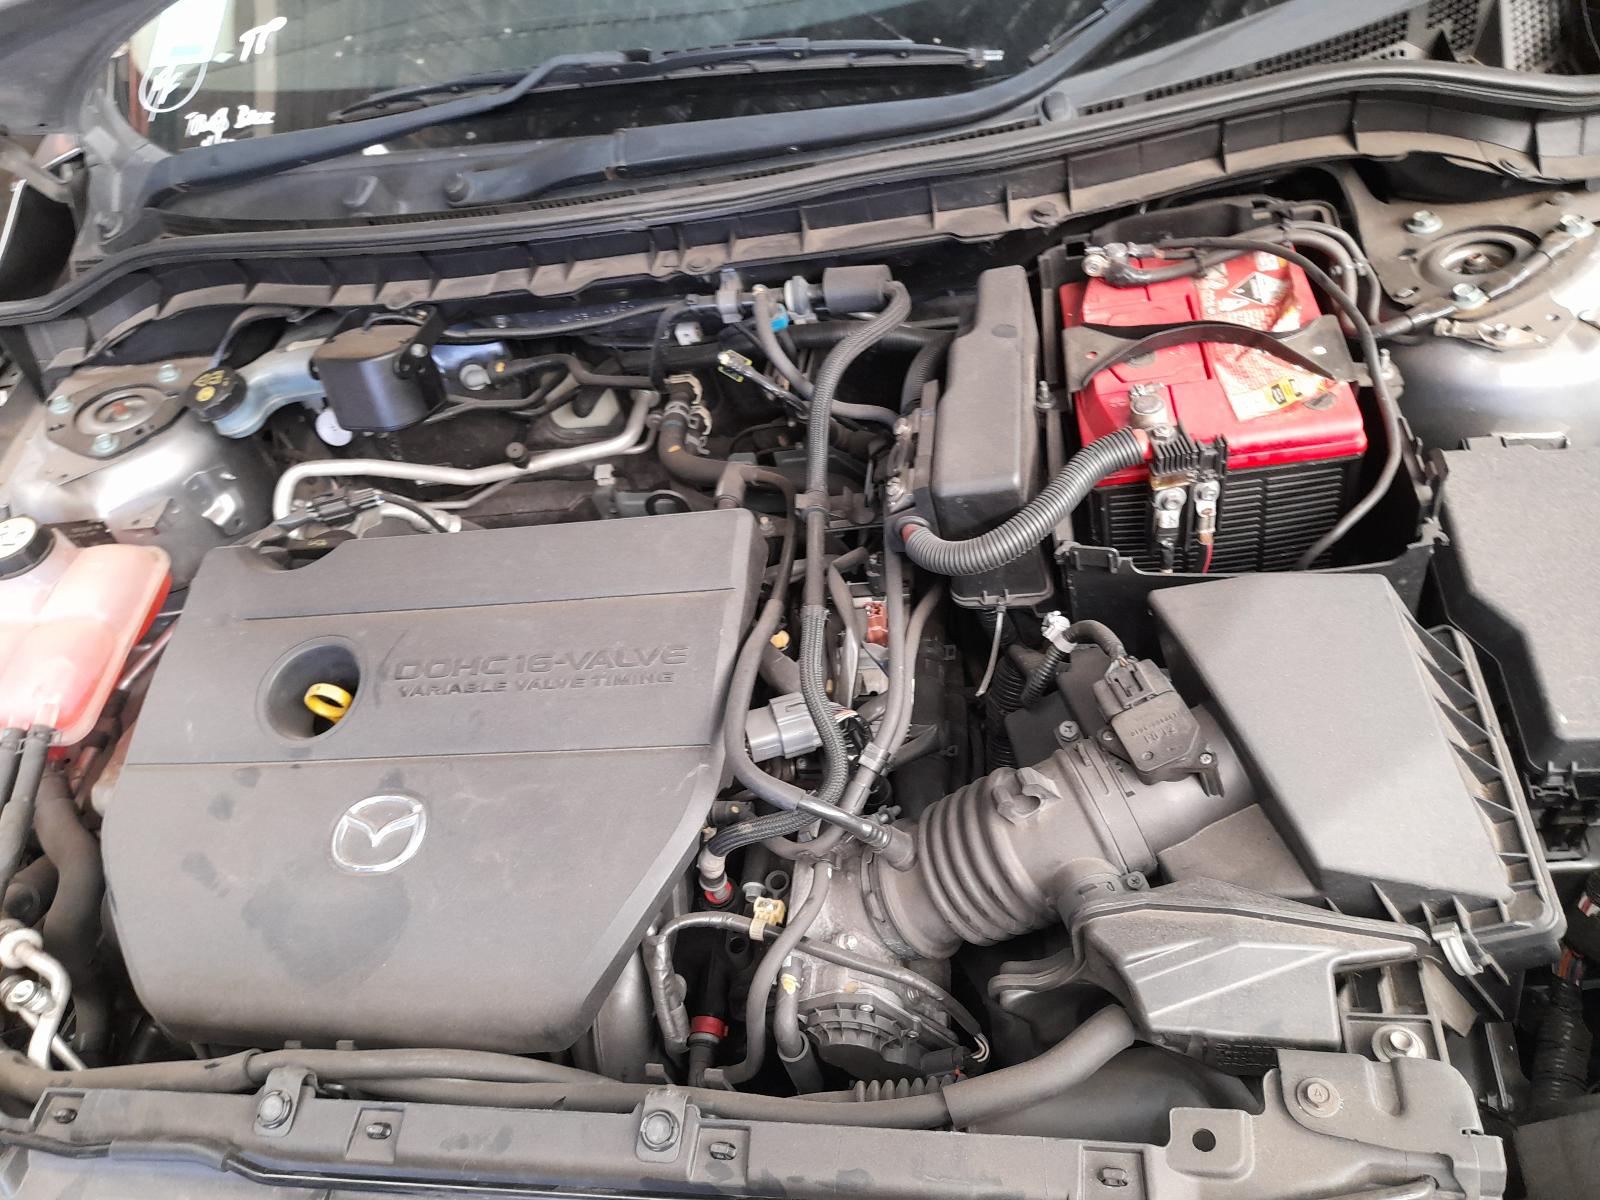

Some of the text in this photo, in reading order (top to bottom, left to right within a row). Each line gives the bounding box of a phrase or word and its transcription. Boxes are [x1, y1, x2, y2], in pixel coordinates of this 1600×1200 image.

[394, 646, 689, 680] DOHC 16-VALVE
[398, 671, 675, 698] VARIABLE VALVE TIMING
